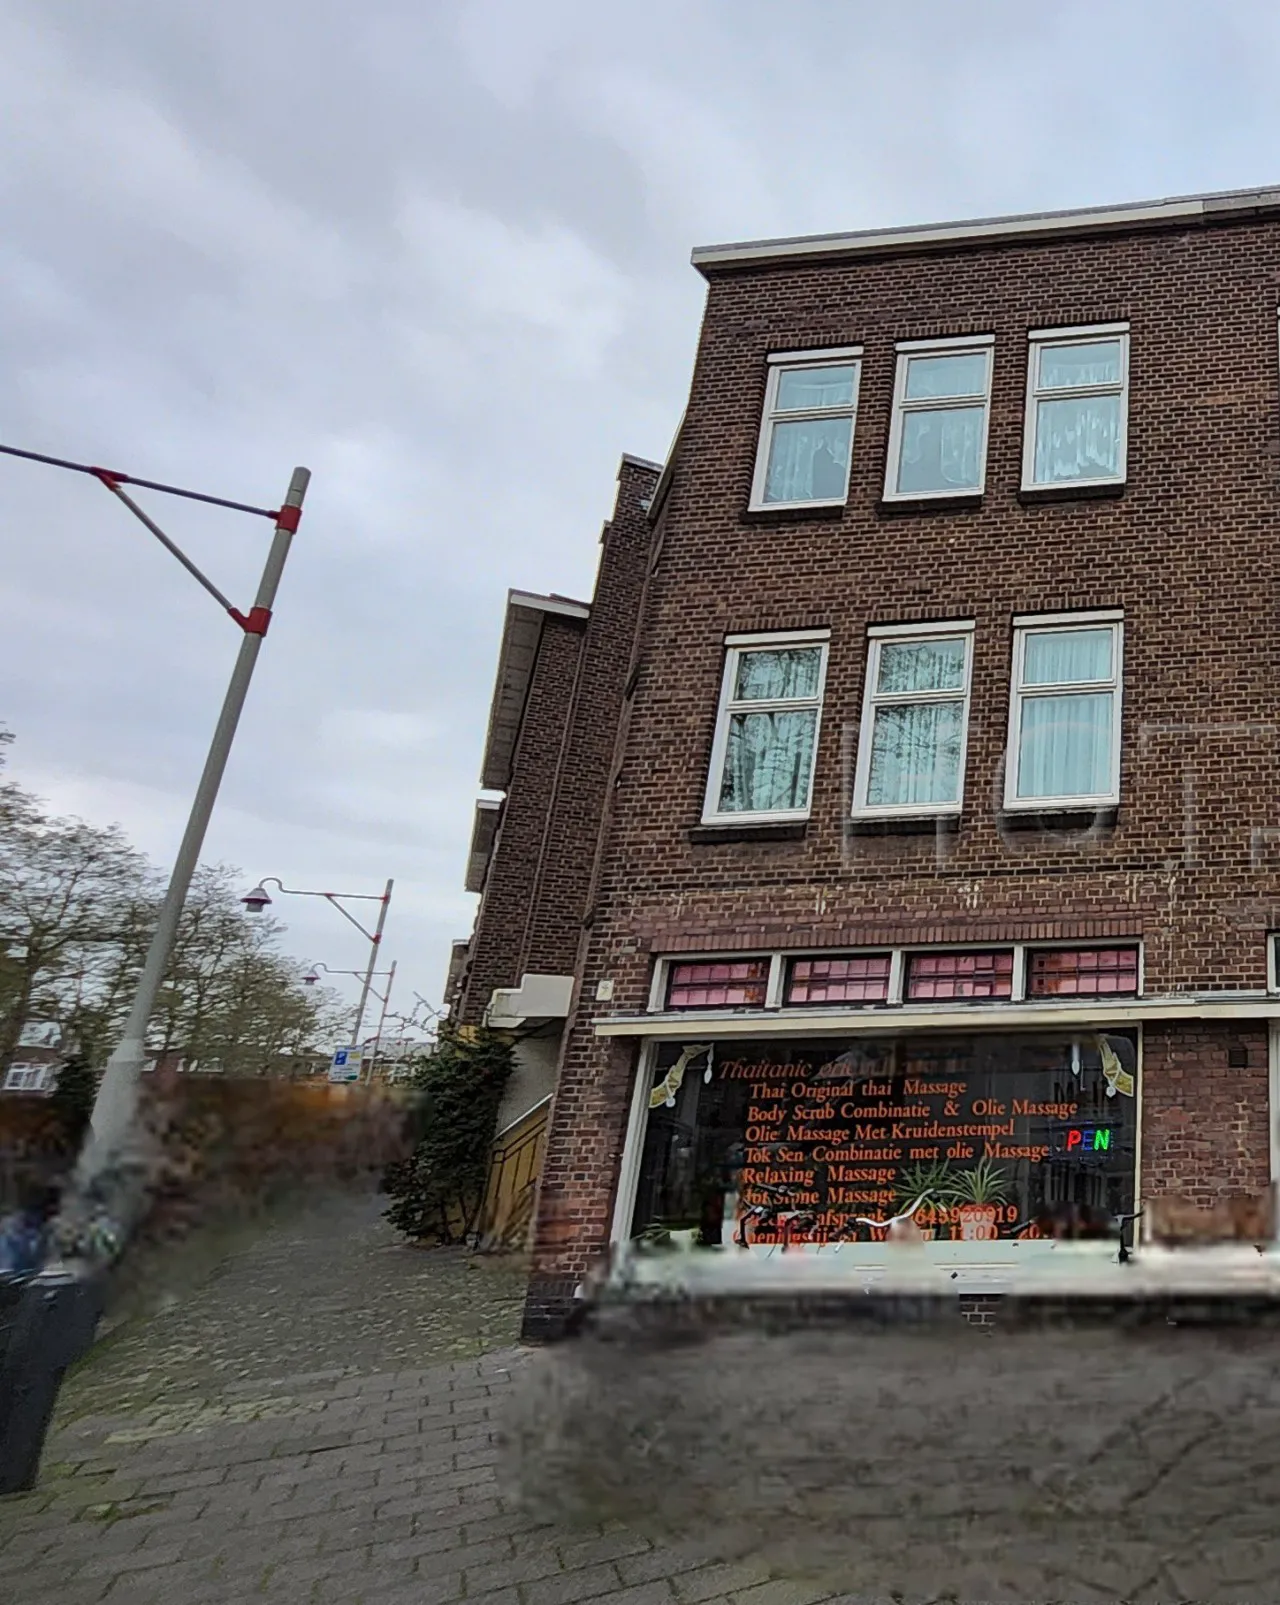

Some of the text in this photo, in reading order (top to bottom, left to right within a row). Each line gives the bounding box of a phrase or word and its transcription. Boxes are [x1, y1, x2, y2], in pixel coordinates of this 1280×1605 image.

[719, 1059, 812, 1080] Thaitanic
[750, 1079, 967, 1102] Thai Original thai Massage
[747, 1099, 1078, 1125] Body Scrub Combinatie & Olie Massage
[745, 1118, 1015, 1146] Olie Massage Met Kruidenstempel
[744, 1140, 1049, 1163] Tok Sen Combinatie met olie Massage
[743, 1164, 897, 1187] Relaxing Massage
[827, 1187, 897, 1207] Massage
